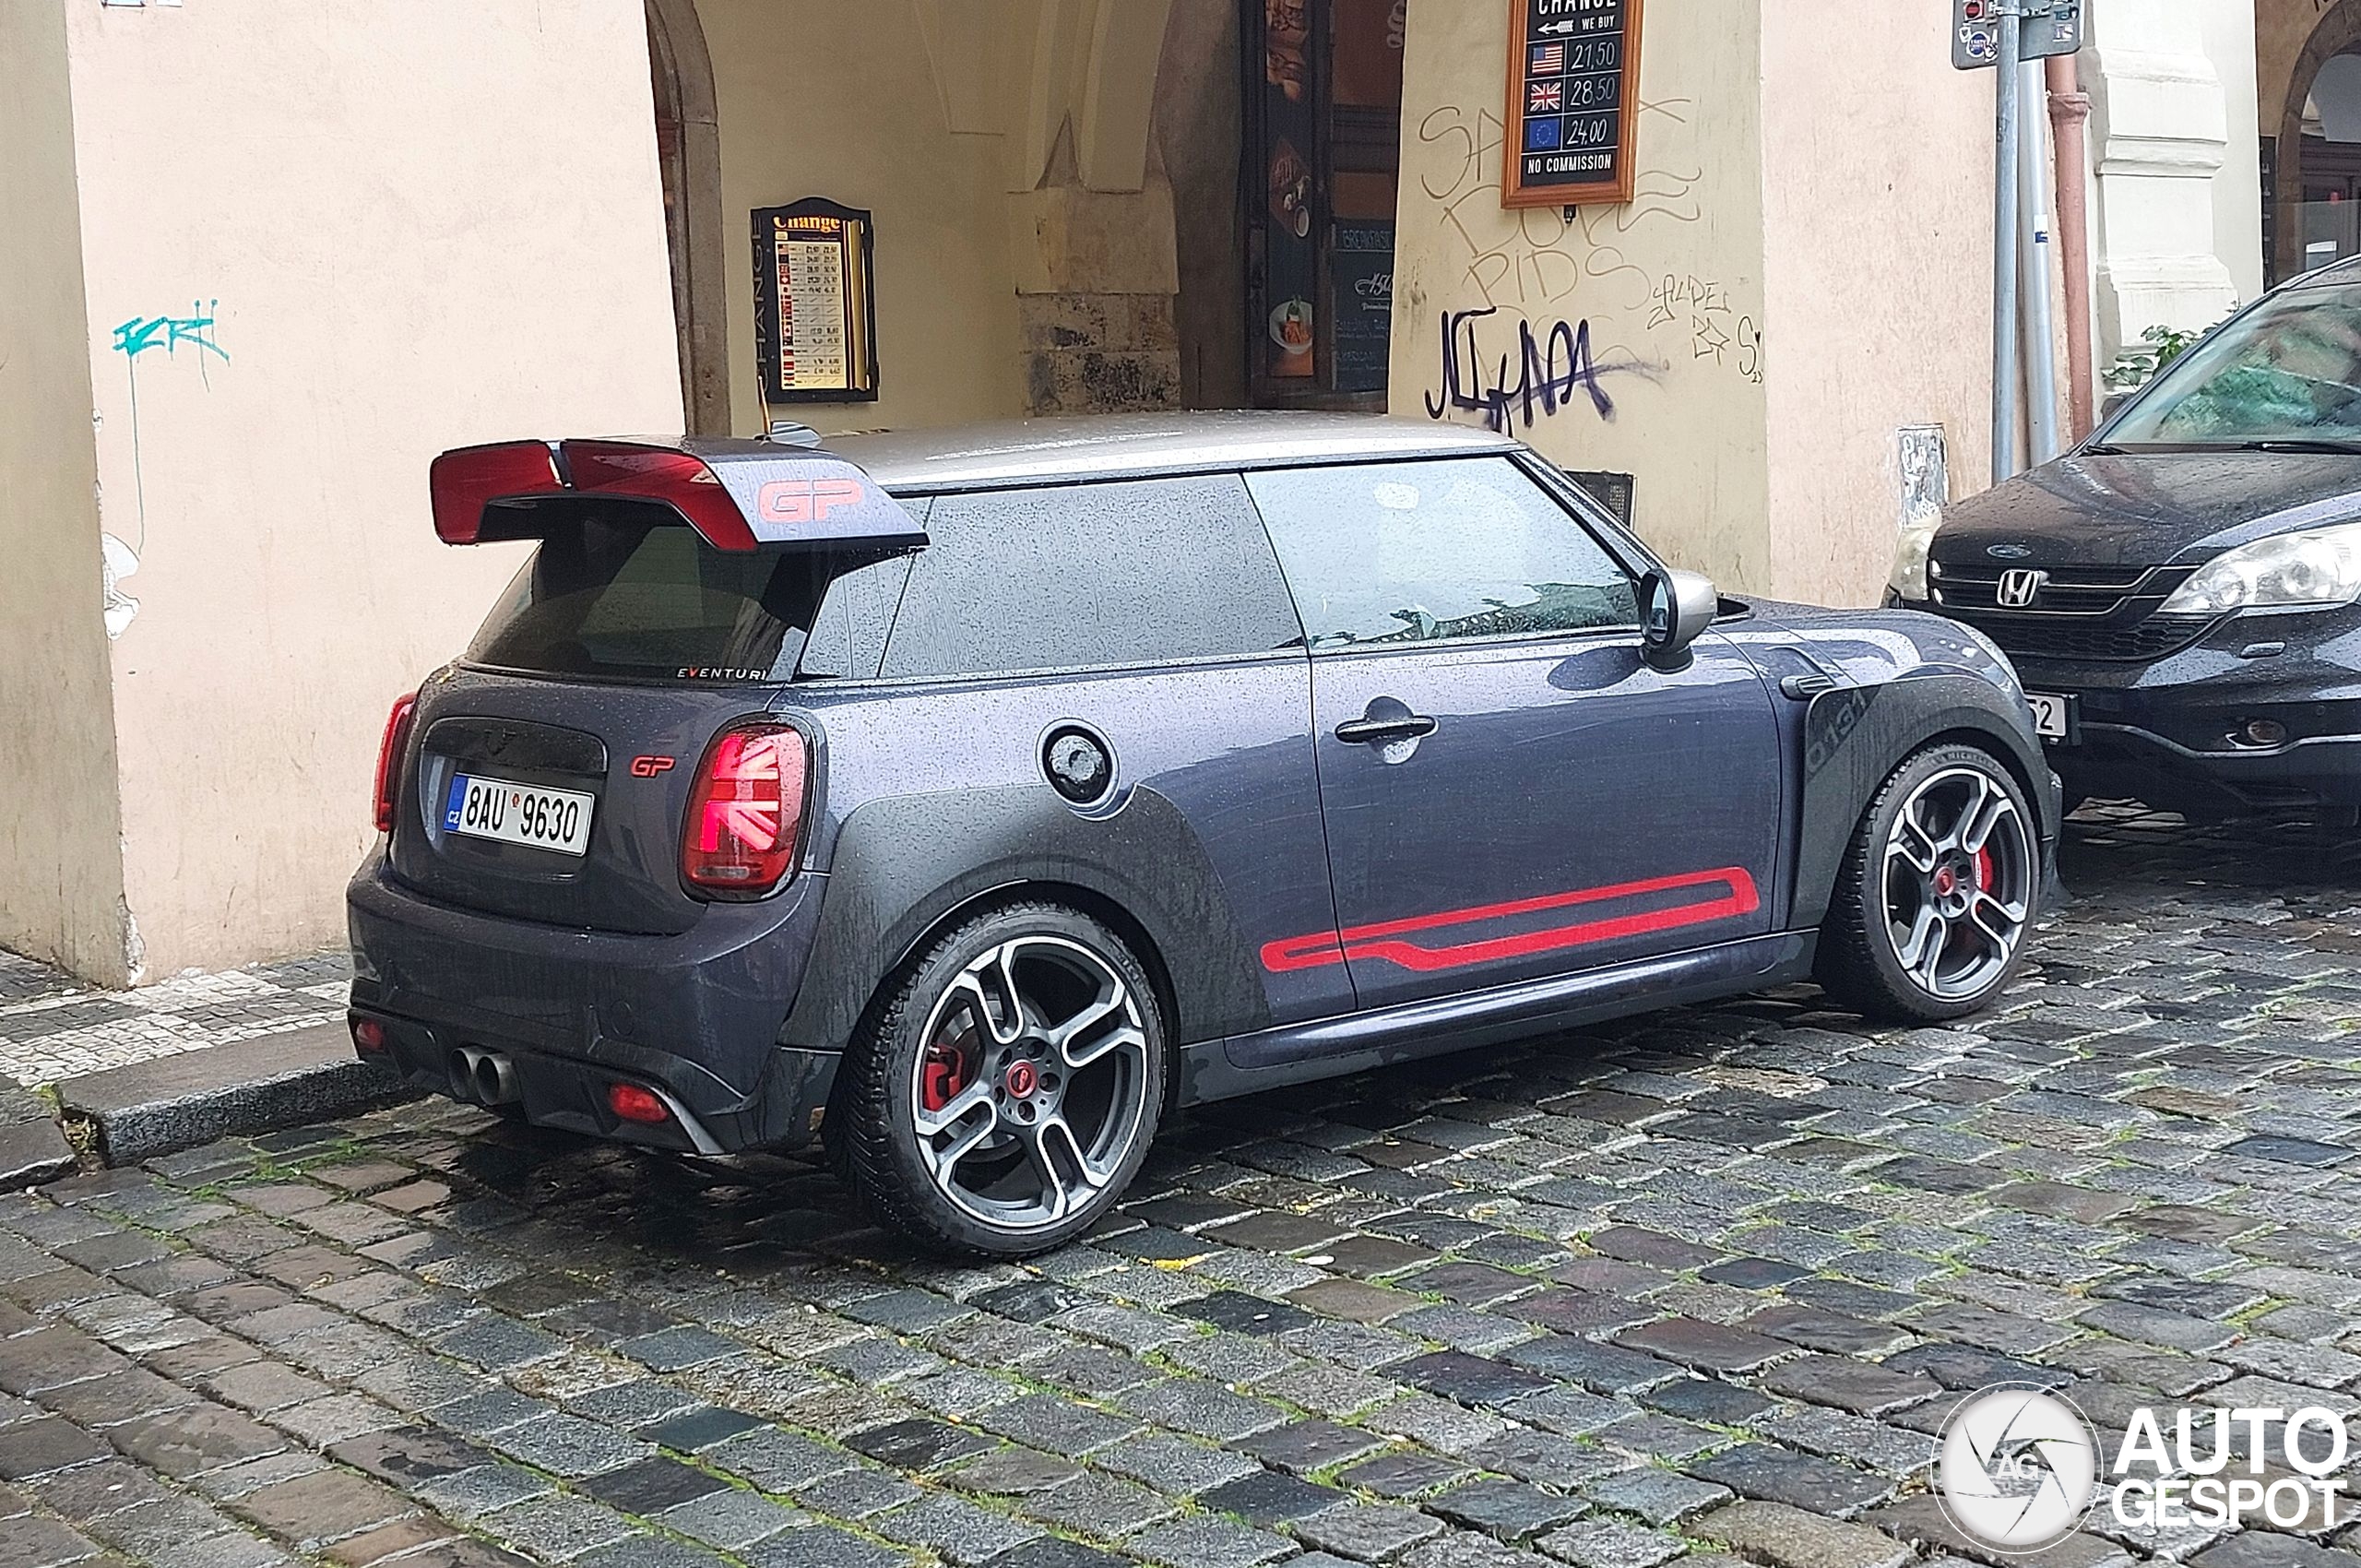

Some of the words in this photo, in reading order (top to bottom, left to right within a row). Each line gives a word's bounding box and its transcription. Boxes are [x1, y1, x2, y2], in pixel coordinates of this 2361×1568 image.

[1582, 17, 1596, 30] WE
[1598, 15, 1615, 29] BUY
[1527, 158, 1541, 174] NO
[1546, 153, 1612, 172] COMMISSION
[773, 216, 841, 233] Change
[758, 479, 863, 523] GP
[677, 667, 767, 681] EVENTURI
[630, 755, 675, 778] GP
[447, 810, 460, 825] CZ
[466, 785, 508, 831] 8AU
[520, 793, 579, 844] 9630
